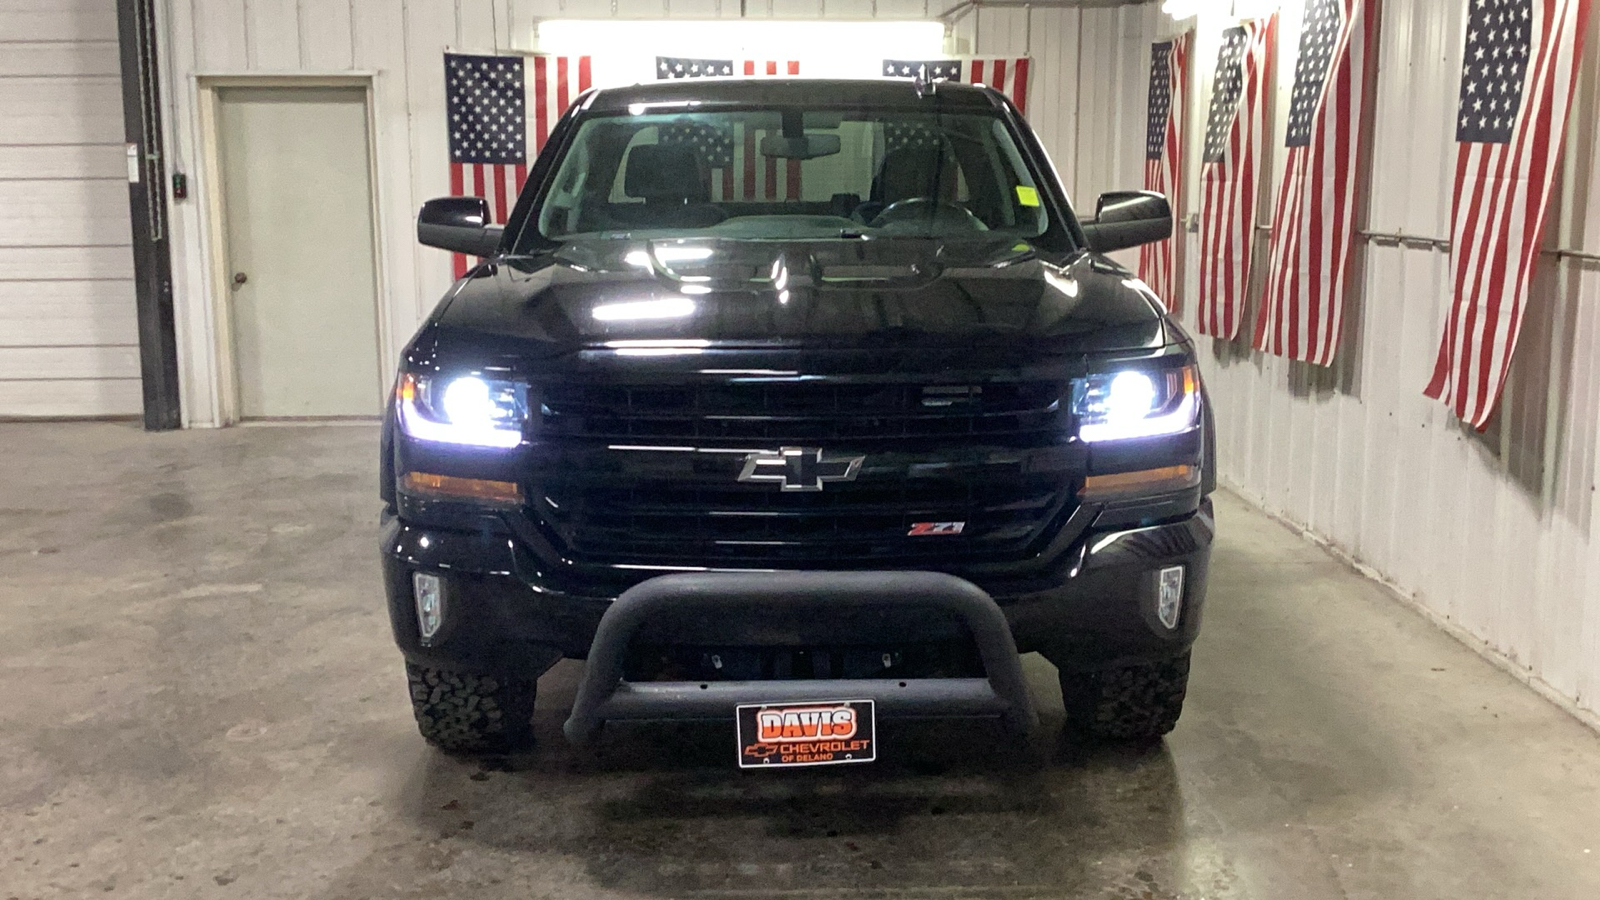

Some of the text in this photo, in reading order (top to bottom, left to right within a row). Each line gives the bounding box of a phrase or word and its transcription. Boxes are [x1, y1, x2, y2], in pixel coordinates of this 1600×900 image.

[907, 521, 966, 536] Z71
[761, 710, 853, 739] DAVIS
[780, 739, 870, 755] CHEVROLET
[781, 753, 834, 763] OF DELANO
